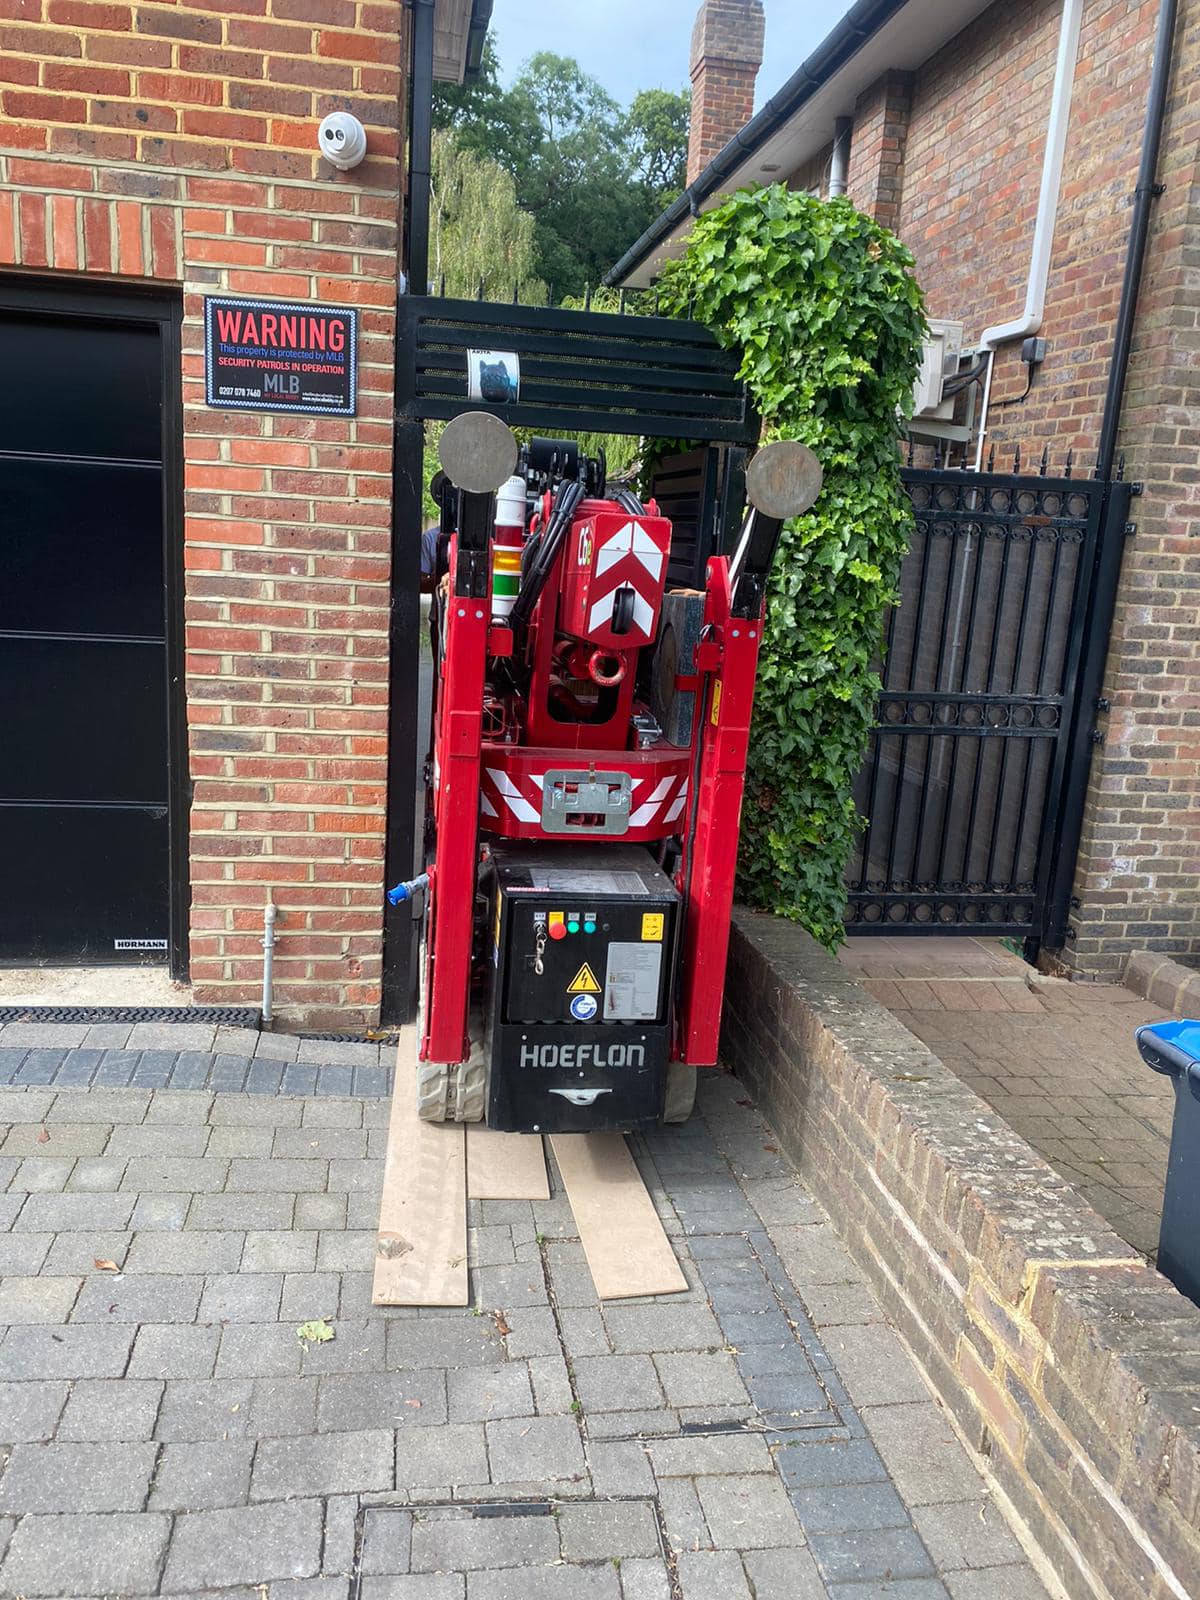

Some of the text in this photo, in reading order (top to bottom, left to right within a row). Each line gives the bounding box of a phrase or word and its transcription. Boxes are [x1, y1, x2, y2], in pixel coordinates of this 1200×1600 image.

[217, 310, 345, 352] WARNING
[218, 343, 344, 362] This property is protected by MLB
[218, 357, 344, 375] SECURITY PATROLS IN OPERATION
[264, 373, 300, 394] MLB
[520, 1045, 645, 1068] HOEFLON
